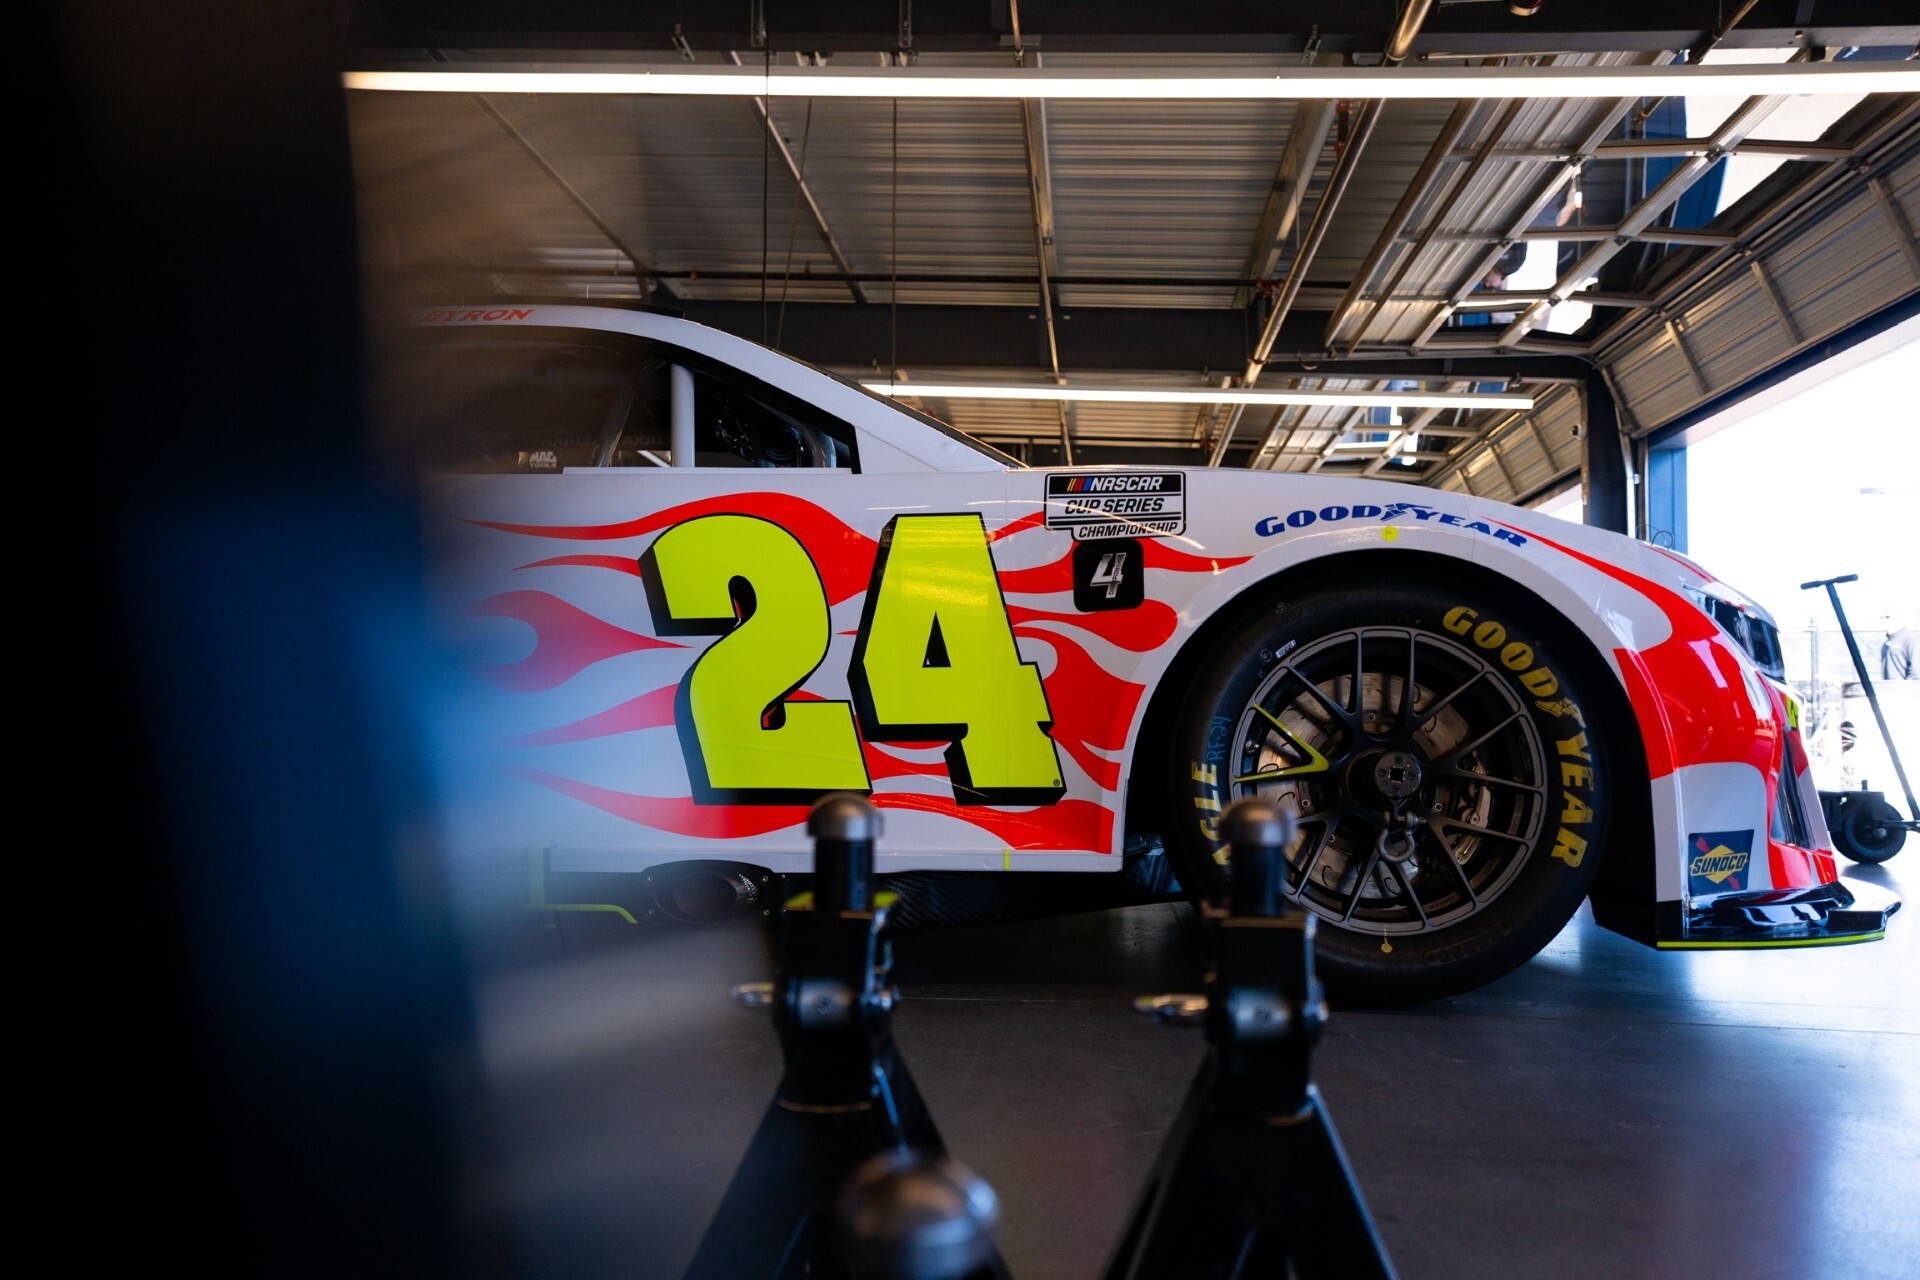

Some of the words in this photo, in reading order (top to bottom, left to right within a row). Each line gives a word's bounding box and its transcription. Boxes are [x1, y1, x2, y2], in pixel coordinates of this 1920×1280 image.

[420, 309, 536, 322] BYRON
[1090, 476, 1164, 492] NASCAR
[1064, 499, 1102, 514] CUP
[1101, 497, 1165, 513] SERIES
[1078, 521, 1179, 538] CHAMPIONSHIP
[1255, 503, 1528, 548] GOODYEAR
[1090, 552, 1127, 598] 4
[638, 512, 1067, 806] 24
[1442, 606, 1595, 868] GOODYEAR
[1691, 853, 1747, 875] SUNOCO
